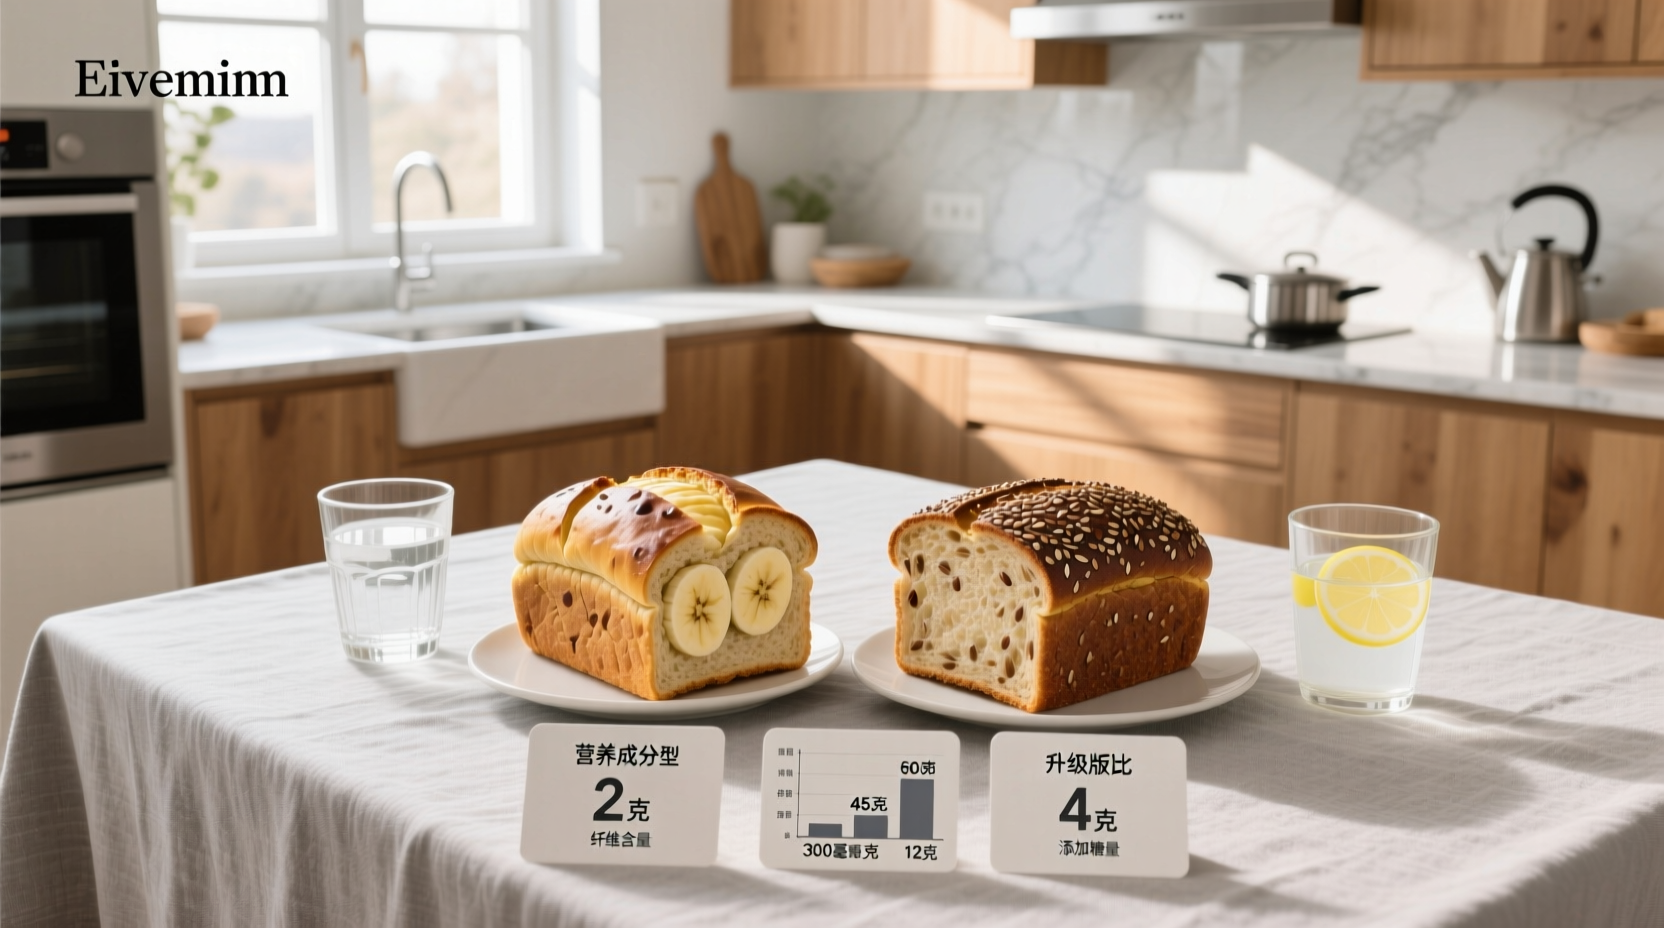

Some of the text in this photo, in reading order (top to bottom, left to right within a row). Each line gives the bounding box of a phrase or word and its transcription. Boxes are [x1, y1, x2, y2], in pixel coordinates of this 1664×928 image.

[575, 742, 680, 767] 营养成分型
[1045, 752, 1133, 776] 升级版比
